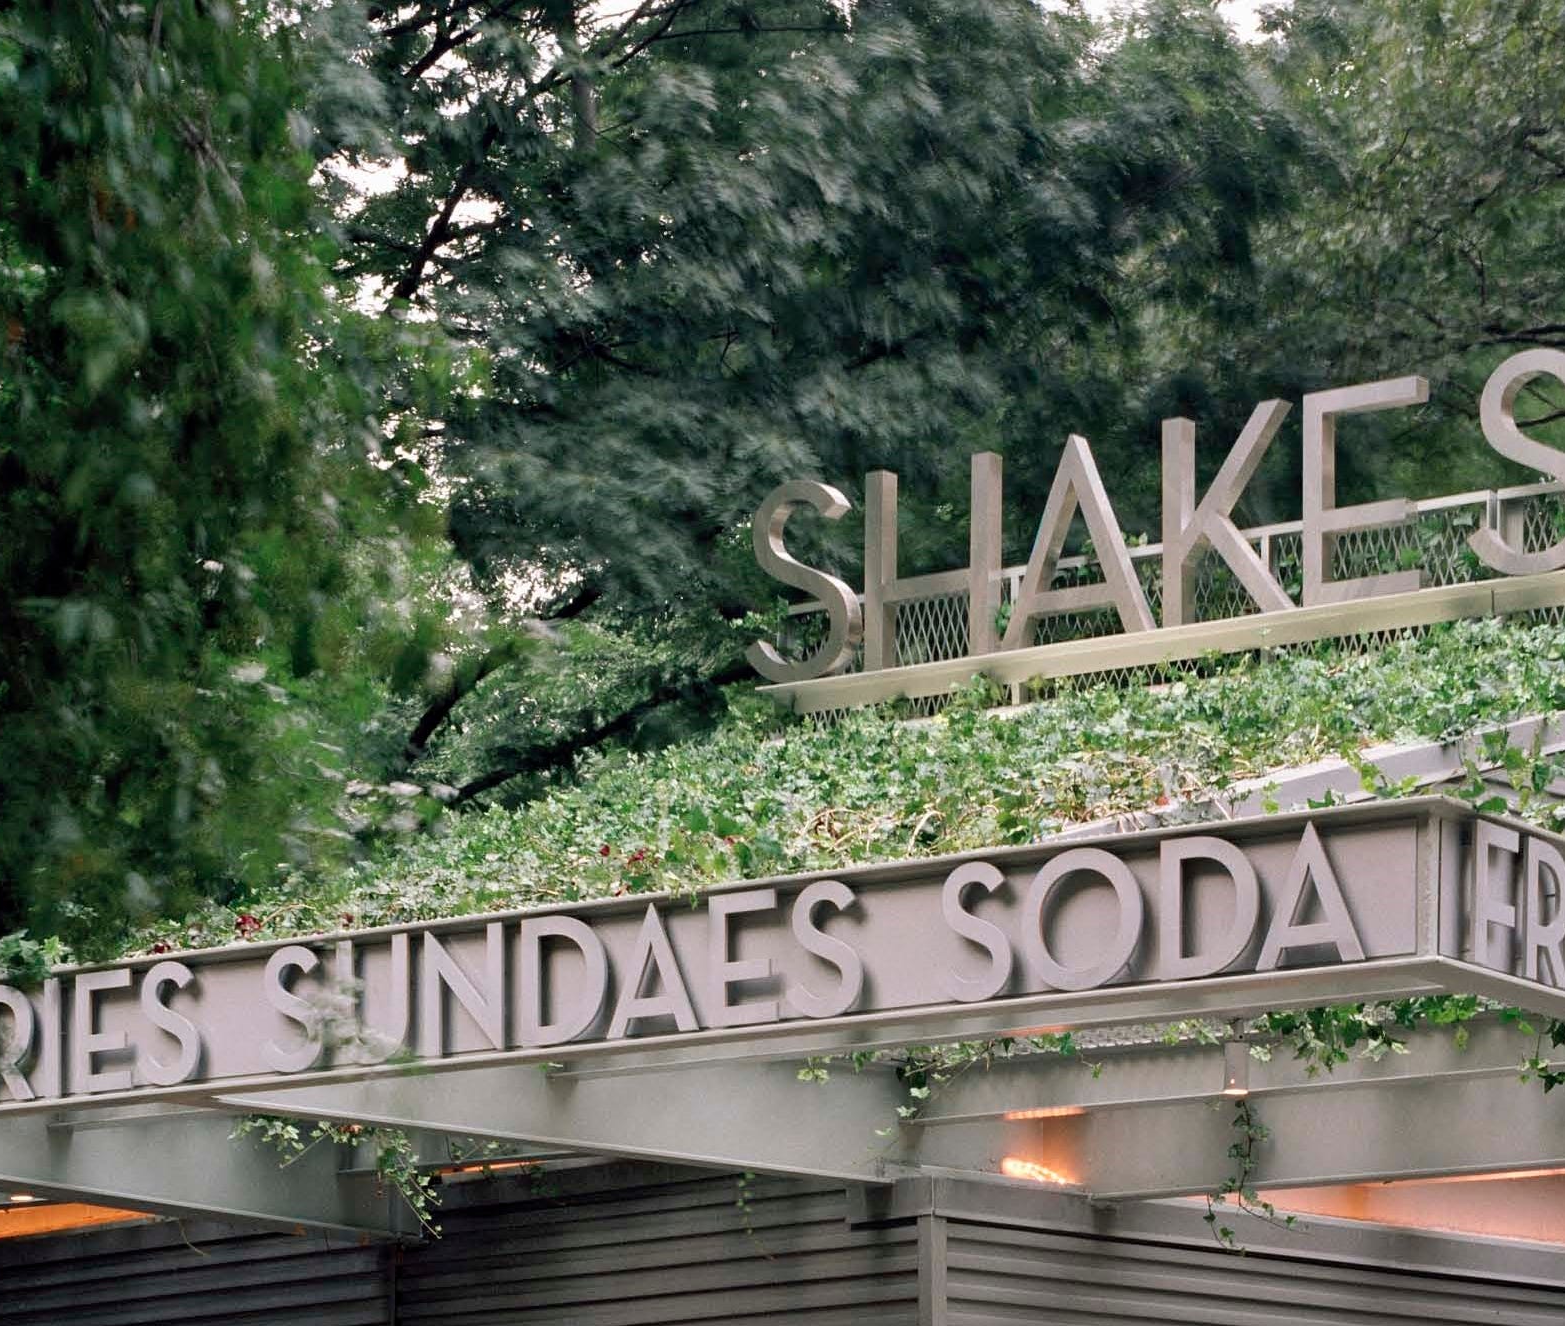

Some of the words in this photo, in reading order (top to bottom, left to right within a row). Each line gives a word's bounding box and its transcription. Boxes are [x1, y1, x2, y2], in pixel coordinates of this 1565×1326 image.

[746, 375, 1429, 684] SHAKE
[260, 880, 865, 1073] SUNDAES
[941, 820, 1366, 1001] SODA
